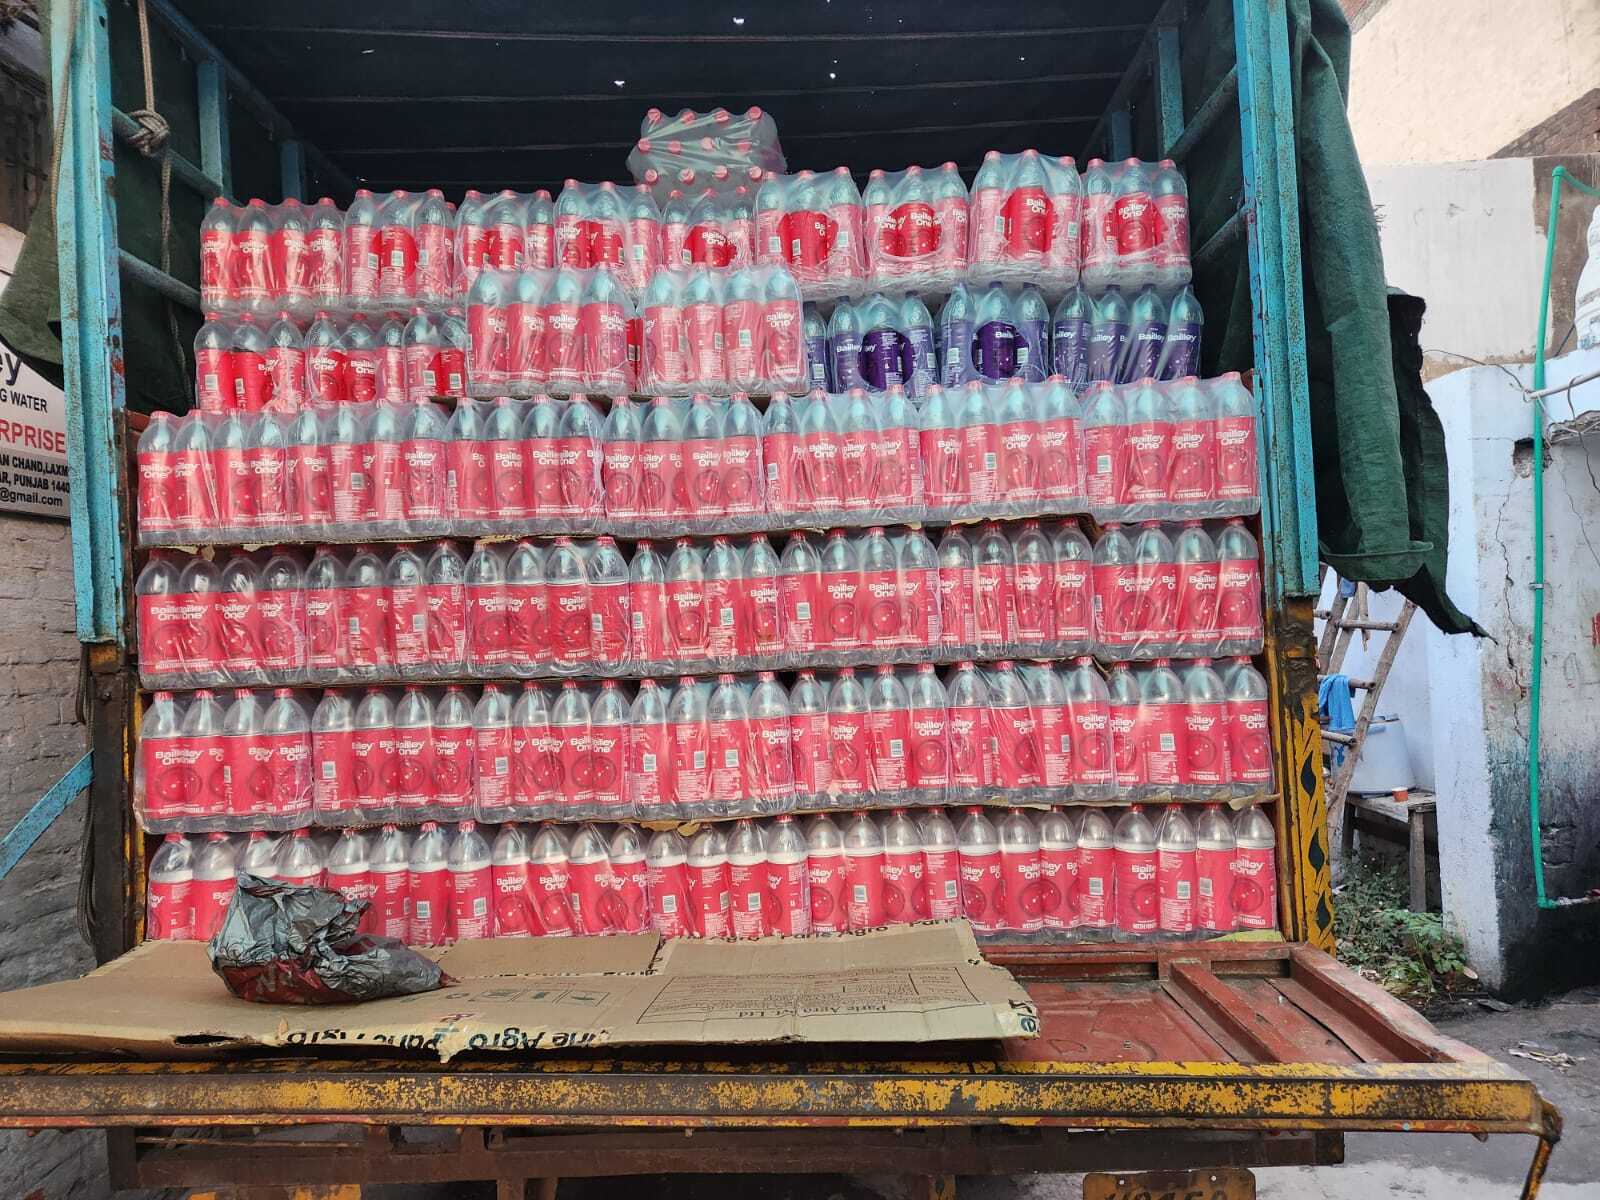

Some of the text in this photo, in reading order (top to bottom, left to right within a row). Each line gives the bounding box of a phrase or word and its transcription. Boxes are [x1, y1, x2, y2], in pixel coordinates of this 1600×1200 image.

[1055, 331, 1075, 339] ailley
[1091, 334, 1114, 343] ailley
[10, 390, 48, 413] WATER
[0, 419, 66, 454] RPRISE
[1136, 442, 1160, 450] One
[1175, 441, 1200, 449] One
[0, 454, 69, 478] AN CHAND,LAXM
[13, 474, 49, 491] PUNJAB
[0, 486, 63, 507] @gmail.com
[827, 585, 857, 594] Bailley
[673, 593, 704, 601] Bailley
[679, 600, 700, 608] One
[1188, 723, 1211, 731] One
[919, 729, 941, 737] One
[1024, 872, 1040, 880] On
[496, 876, 527, 886] Bailley
[500, 884, 522, 892] One
